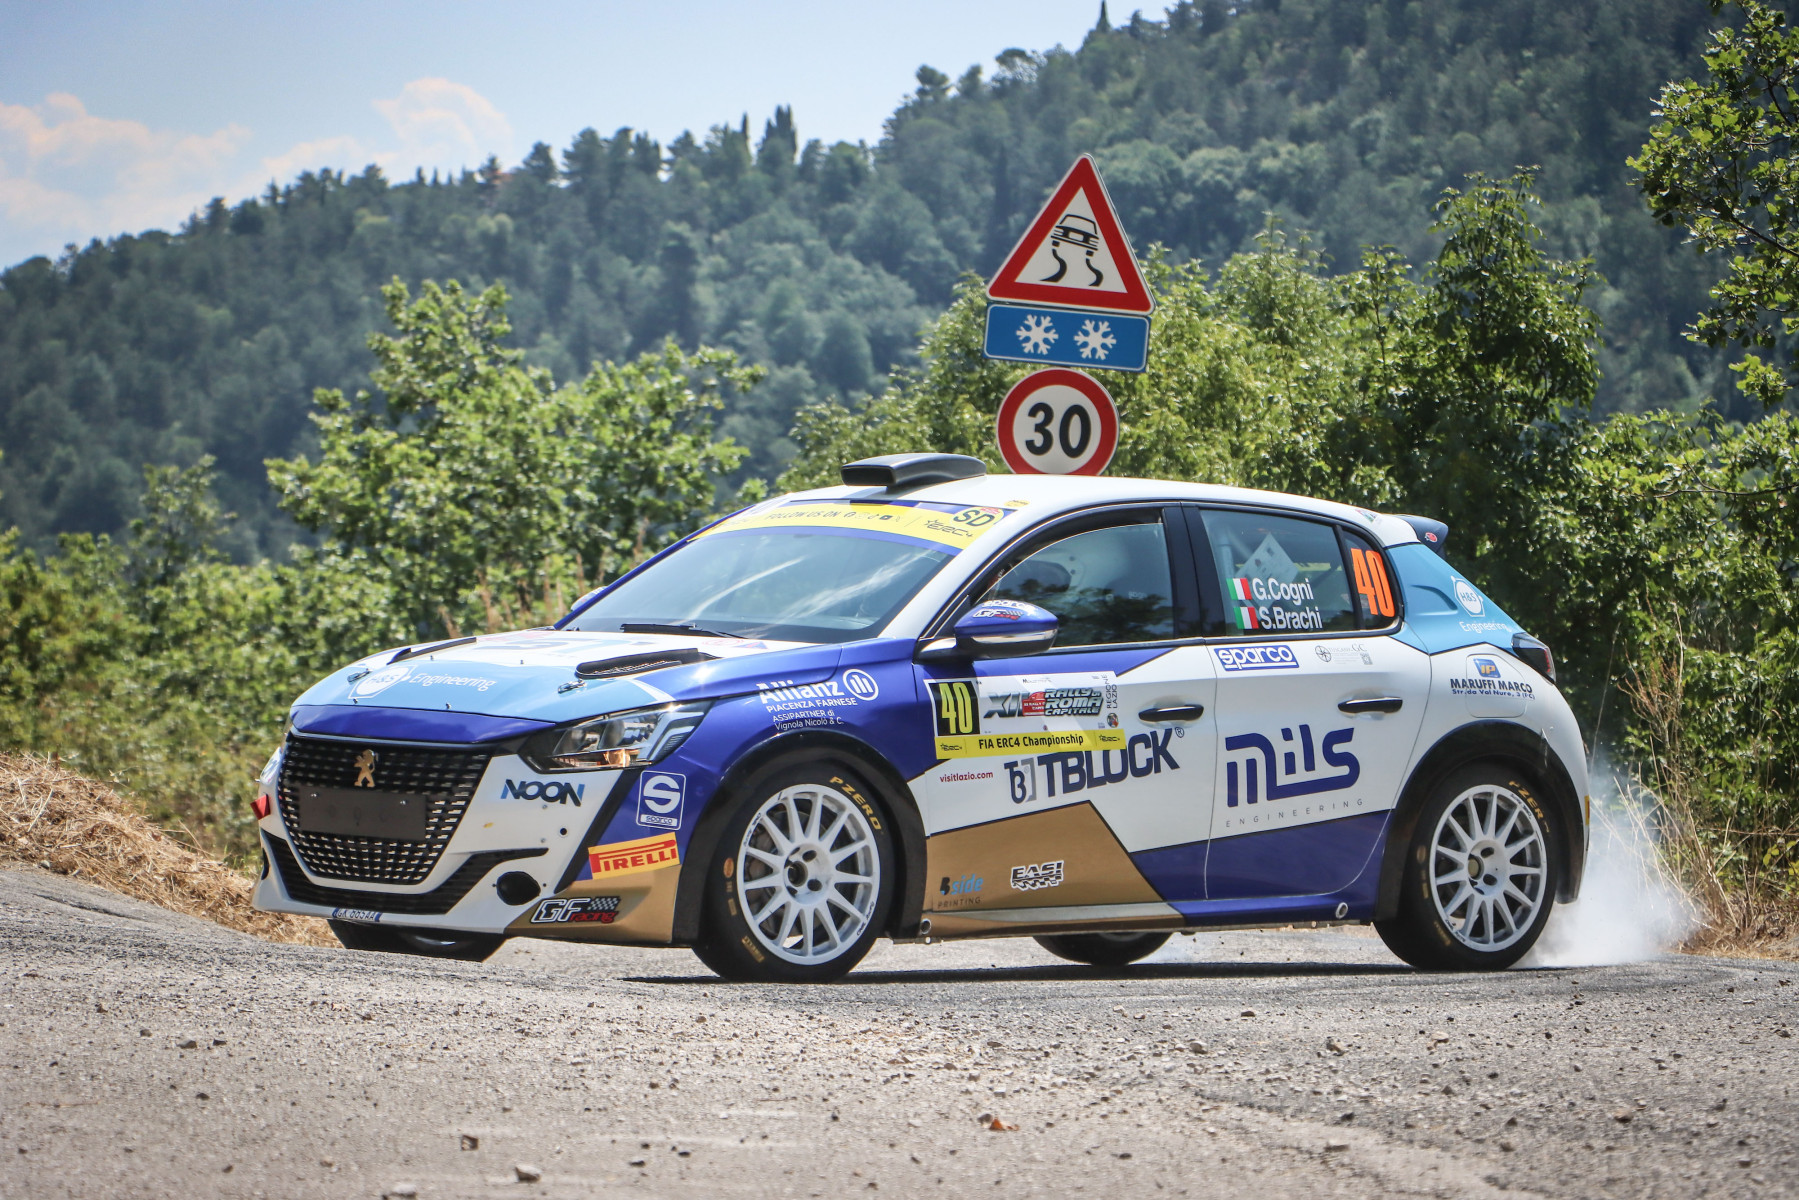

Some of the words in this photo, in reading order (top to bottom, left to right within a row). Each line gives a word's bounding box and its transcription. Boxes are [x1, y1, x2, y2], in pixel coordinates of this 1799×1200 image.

[1025, 402, 1092, 459] 30
[953, 510, 995, 527] SD
[1351, 547, 1395, 617] 40
[1252, 578, 1314, 605] G.Cogni
[1258, 606, 1323, 630] S.Brachi
[1219, 646, 1293, 669] sparco
[1481, 665, 1496, 675] IP
[409, 672, 497, 692] Engineering
[1450, 679, 1496, 690] MARUFFI
[1498, 681, 1533, 693] MARCO
[756, 680, 845, 704] Allianz
[1044, 688, 1092, 698] RALLY
[1102, 674, 1111, 709] REGIONE
[766, 701, 815, 713] PIACENZA
[816, 697, 858, 707] FARNESE
[939, 682, 973, 734] 40
[1044, 697, 1103, 709] ROMA
[1044, 707, 1100, 716] CAPITALE
[773, 711, 826, 722] ASSIPARTNER
[828, 709, 835, 717] di
[775, 721, 803, 731] Vignola
[805, 718, 828, 727] Nicolò
[979, 738, 994, 750] FIA
[997, 737, 1021, 748] ERC4
[1023, 734, 1084, 749] Championship
[940, 771, 993, 783] visitlazio.com
[500, 778, 586, 807] NOON
[646, 815, 673, 825] sparco
[1226, 798, 1363, 828] ENGINEERING
[589, 839, 678, 874] PIRELLI
[531, 898, 591, 923] GF
[938, 897, 981, 909] PRINTING
[570, 911, 618, 924] racing
